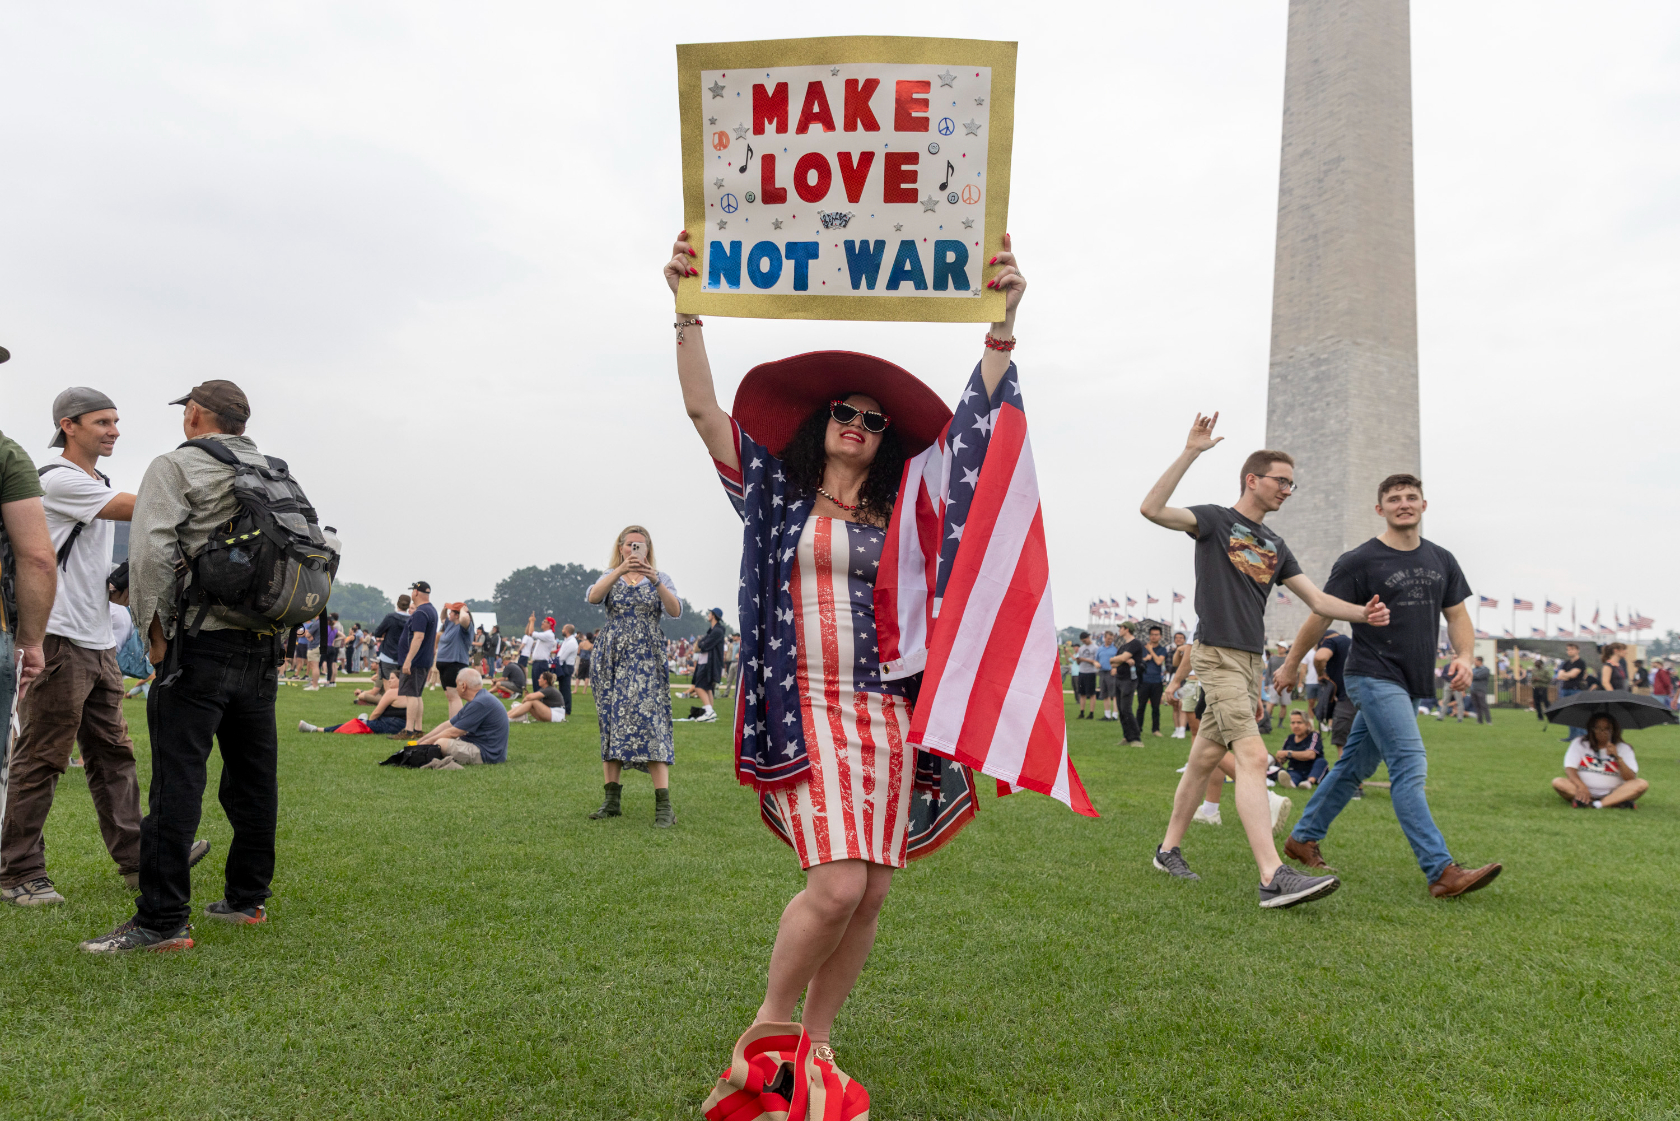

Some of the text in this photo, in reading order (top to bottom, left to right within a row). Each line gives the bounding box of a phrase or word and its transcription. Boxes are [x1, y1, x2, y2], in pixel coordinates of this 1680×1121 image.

[752, 78, 930, 135] MAKE
[761, 151, 919, 204] LOVE
[708, 240, 970, 290] NOT WAR
